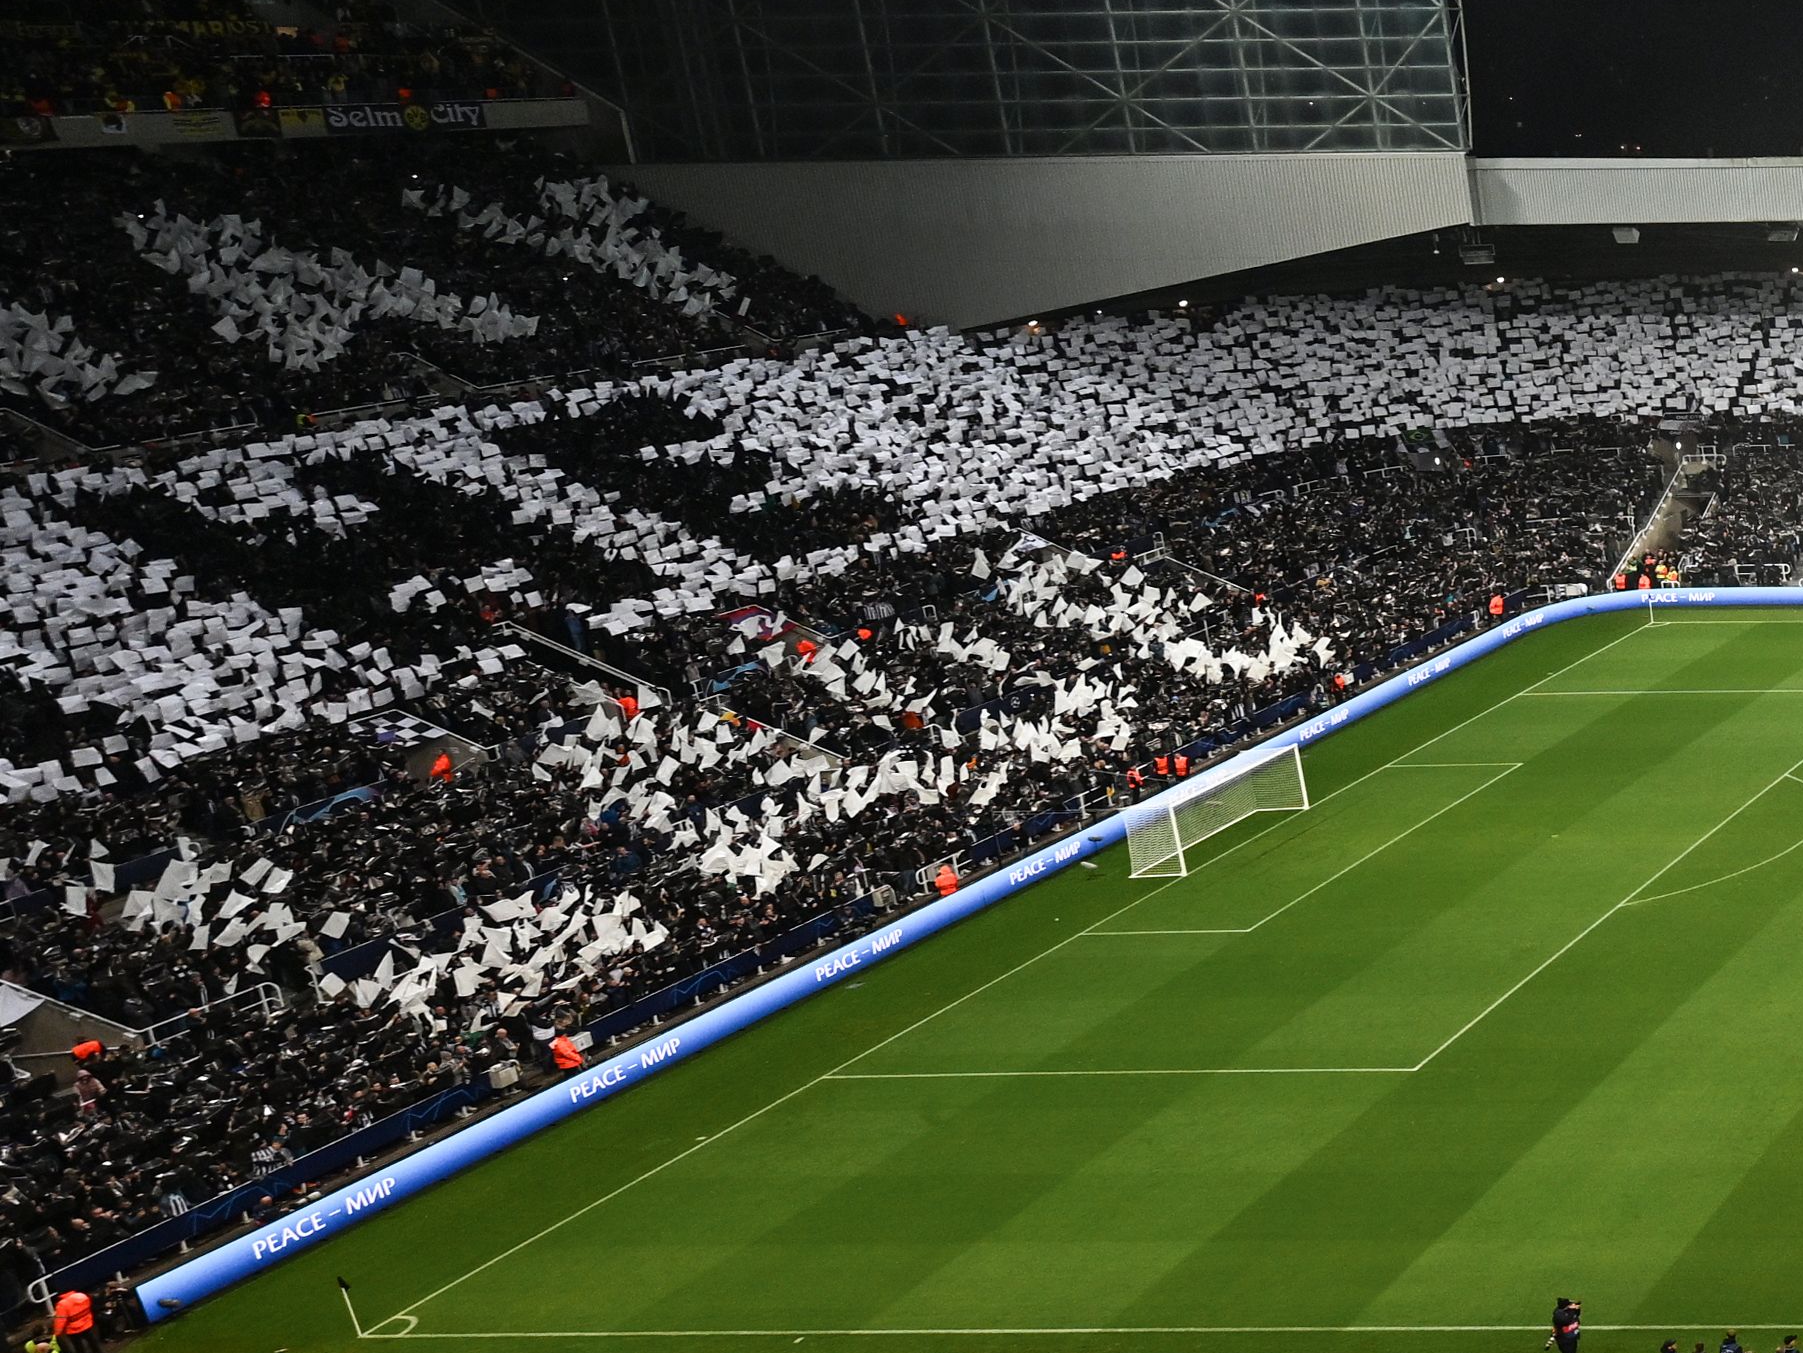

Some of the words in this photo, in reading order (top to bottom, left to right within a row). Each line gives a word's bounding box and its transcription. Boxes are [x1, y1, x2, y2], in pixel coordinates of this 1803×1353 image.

[325, 105, 404, 128] Selm
[430, 103, 481, 127] City
[1688, 592, 1715, 602] МИР
[1502, 623, 1522, 639] PEACE
[1407, 670, 1431, 686] PEACE
[1299, 724, 1327, 741] PEACE
[1009, 860, 1047, 885] PEACE
[1055, 841, 1082, 863] МИР
[569, 1064, 627, 1103] PEACE
[640, 1037, 681, 1069] МИР
[251, 1211, 326, 1261] PEACE
[345, 1177, 396, 1215] МИР
